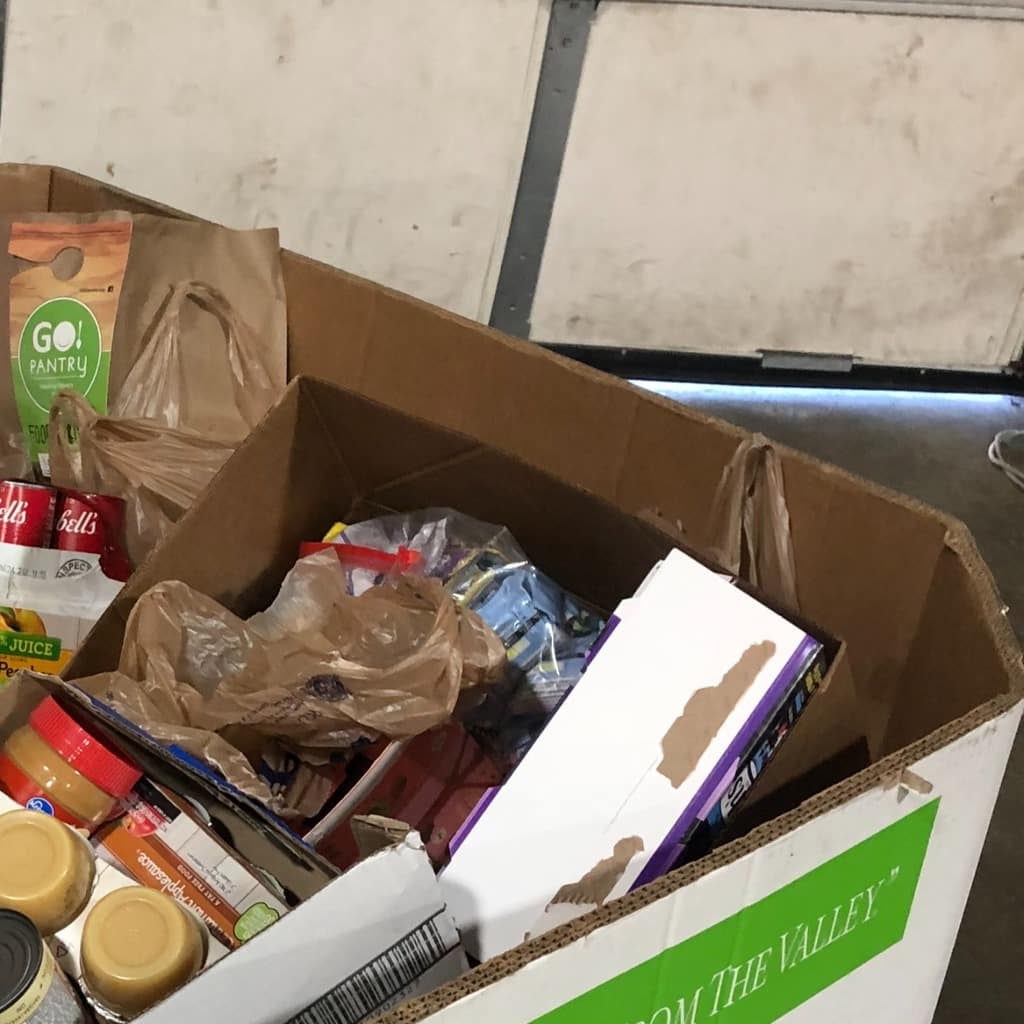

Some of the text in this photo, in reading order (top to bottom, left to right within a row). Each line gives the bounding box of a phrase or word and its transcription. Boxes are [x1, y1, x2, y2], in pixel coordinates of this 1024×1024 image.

[32, 319, 83, 352] GO!
[29, 357, 88, 379] PANTRY
[9, 639, 54, 656] JUICE
[708, 946, 773, 1018] THE
